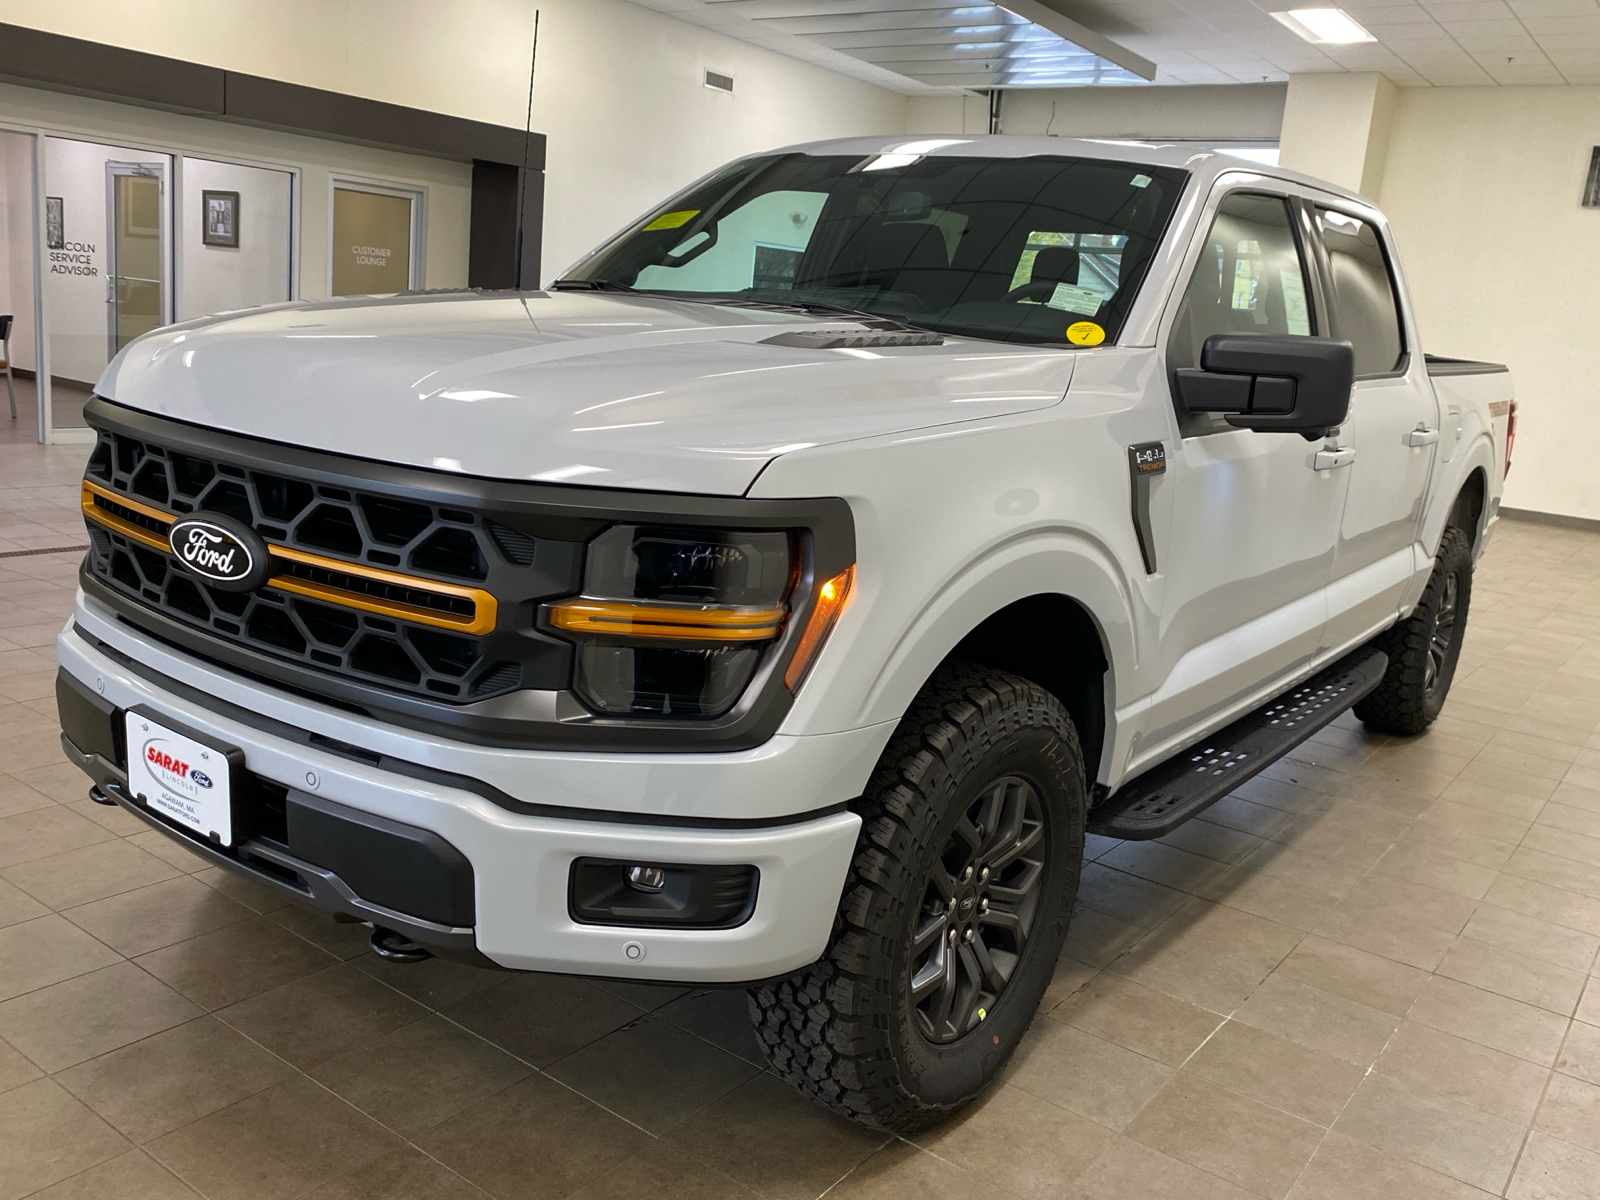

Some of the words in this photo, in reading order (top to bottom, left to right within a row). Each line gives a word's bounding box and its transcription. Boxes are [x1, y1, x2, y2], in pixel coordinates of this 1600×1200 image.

[49, 239, 96, 253] NCOLN
[352, 245, 392, 257] CUSTOMER
[49, 252, 92, 264] SERVICE
[356, 255, 387, 267] LOUNGE
[50, 264, 98, 277] ADVISOR
[183, 527, 236, 574] Ford
[147, 746, 189, 778] SARAT
[166, 773, 195, 792] LINCOLN
[194, 771, 210, 786] Ford
[186, 804, 196, 815] MA
